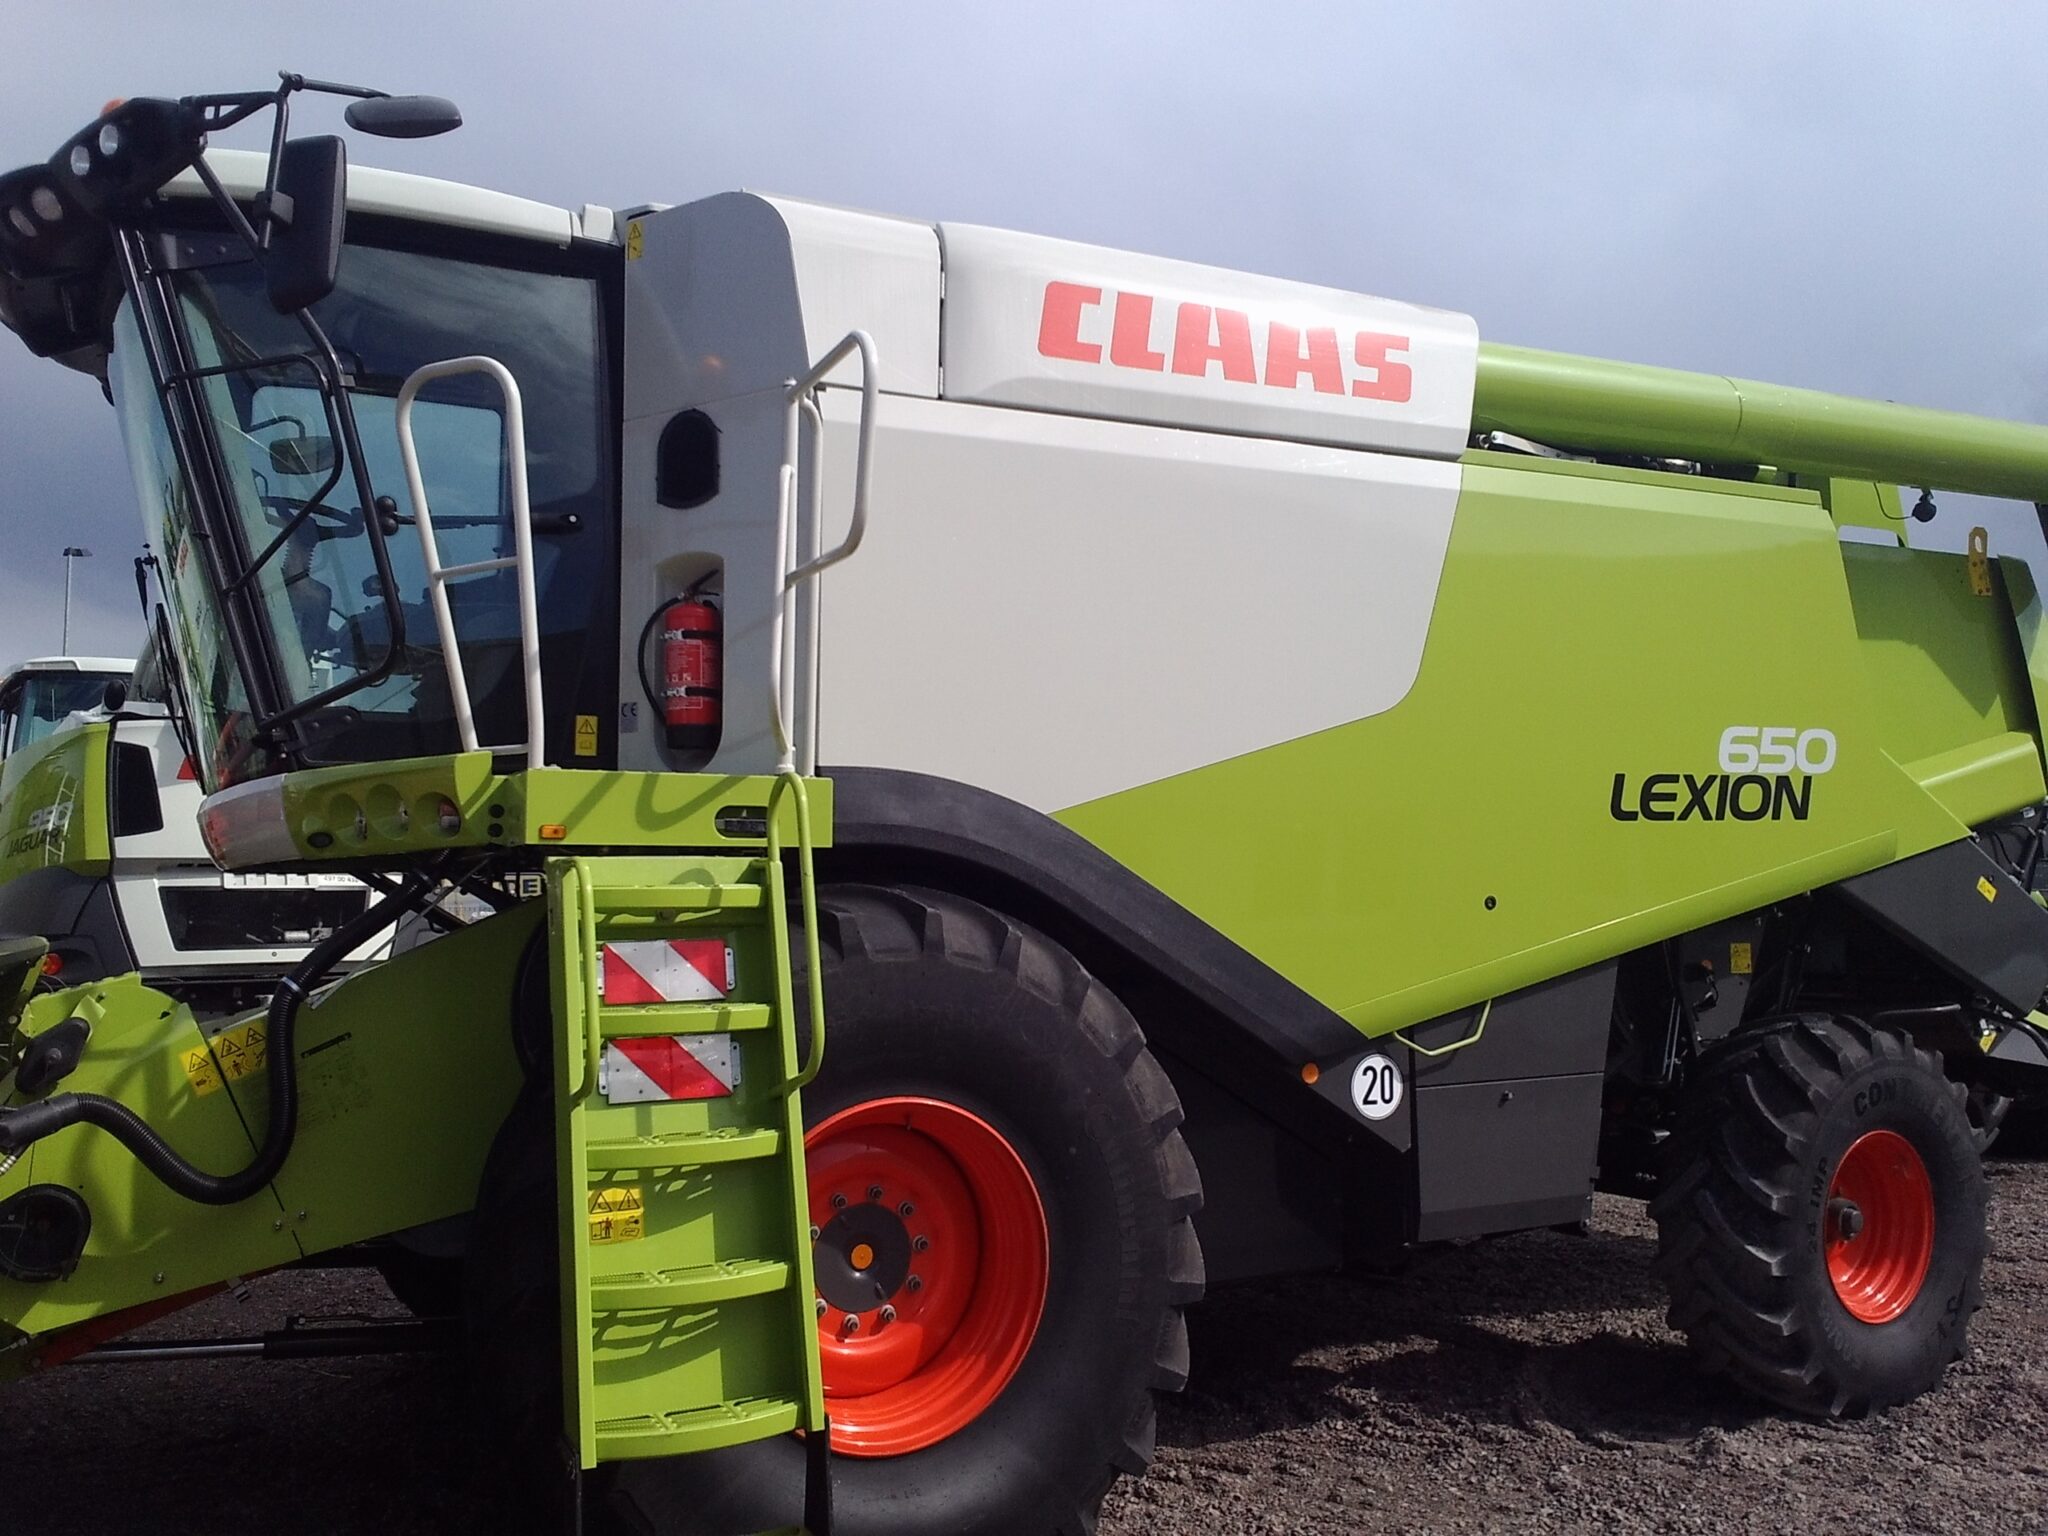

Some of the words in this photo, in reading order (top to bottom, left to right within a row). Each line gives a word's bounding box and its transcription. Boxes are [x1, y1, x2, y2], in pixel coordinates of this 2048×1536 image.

[1037, 280, 1412, 403] CLAAS
[1718, 726, 1836, 774] 650
[1610, 773, 1813, 821] LEXION
[6, 826, 61, 859] JAGUAR
[1362, 1064, 1394, 1105] 20
